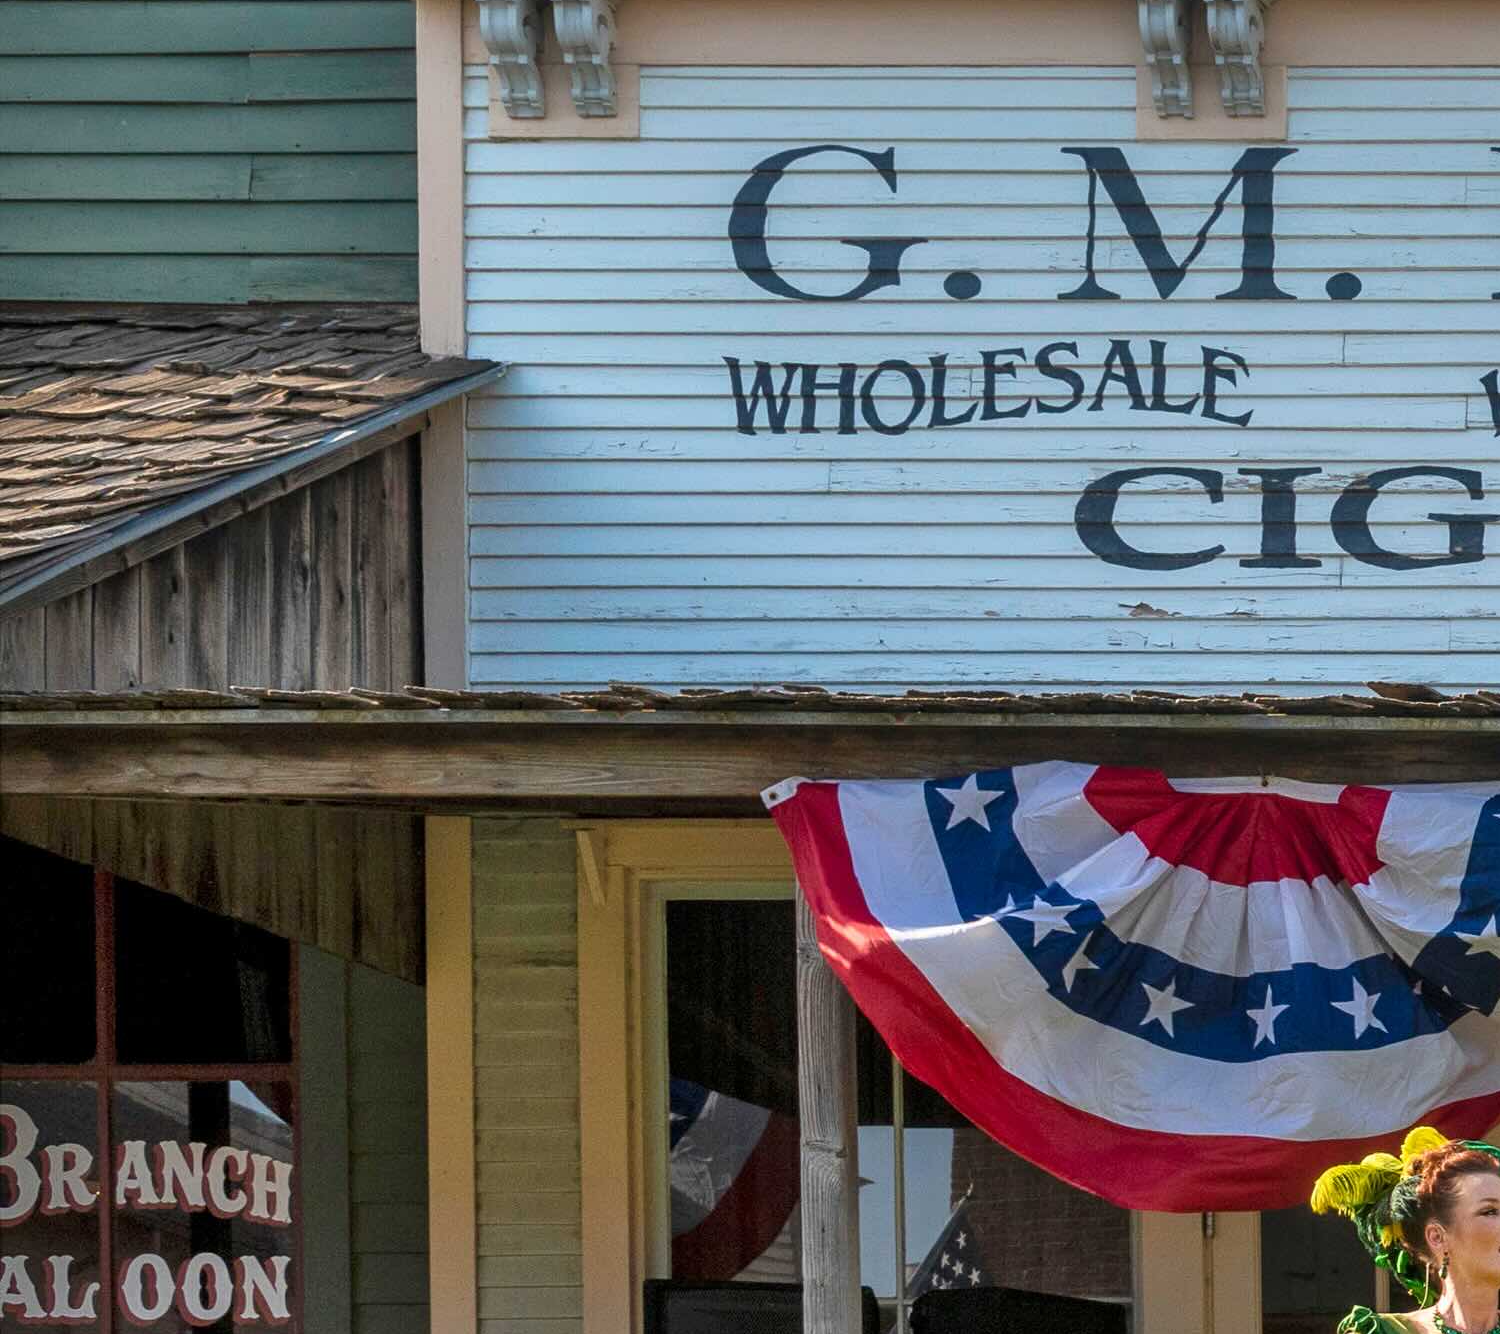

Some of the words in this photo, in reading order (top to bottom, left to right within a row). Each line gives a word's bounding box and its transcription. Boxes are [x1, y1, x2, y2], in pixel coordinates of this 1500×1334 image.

[727, 144, 984, 301] G.
[1056, 146, 1363, 301] M.
[722, 339, 1255, 437] WHOLESALE
